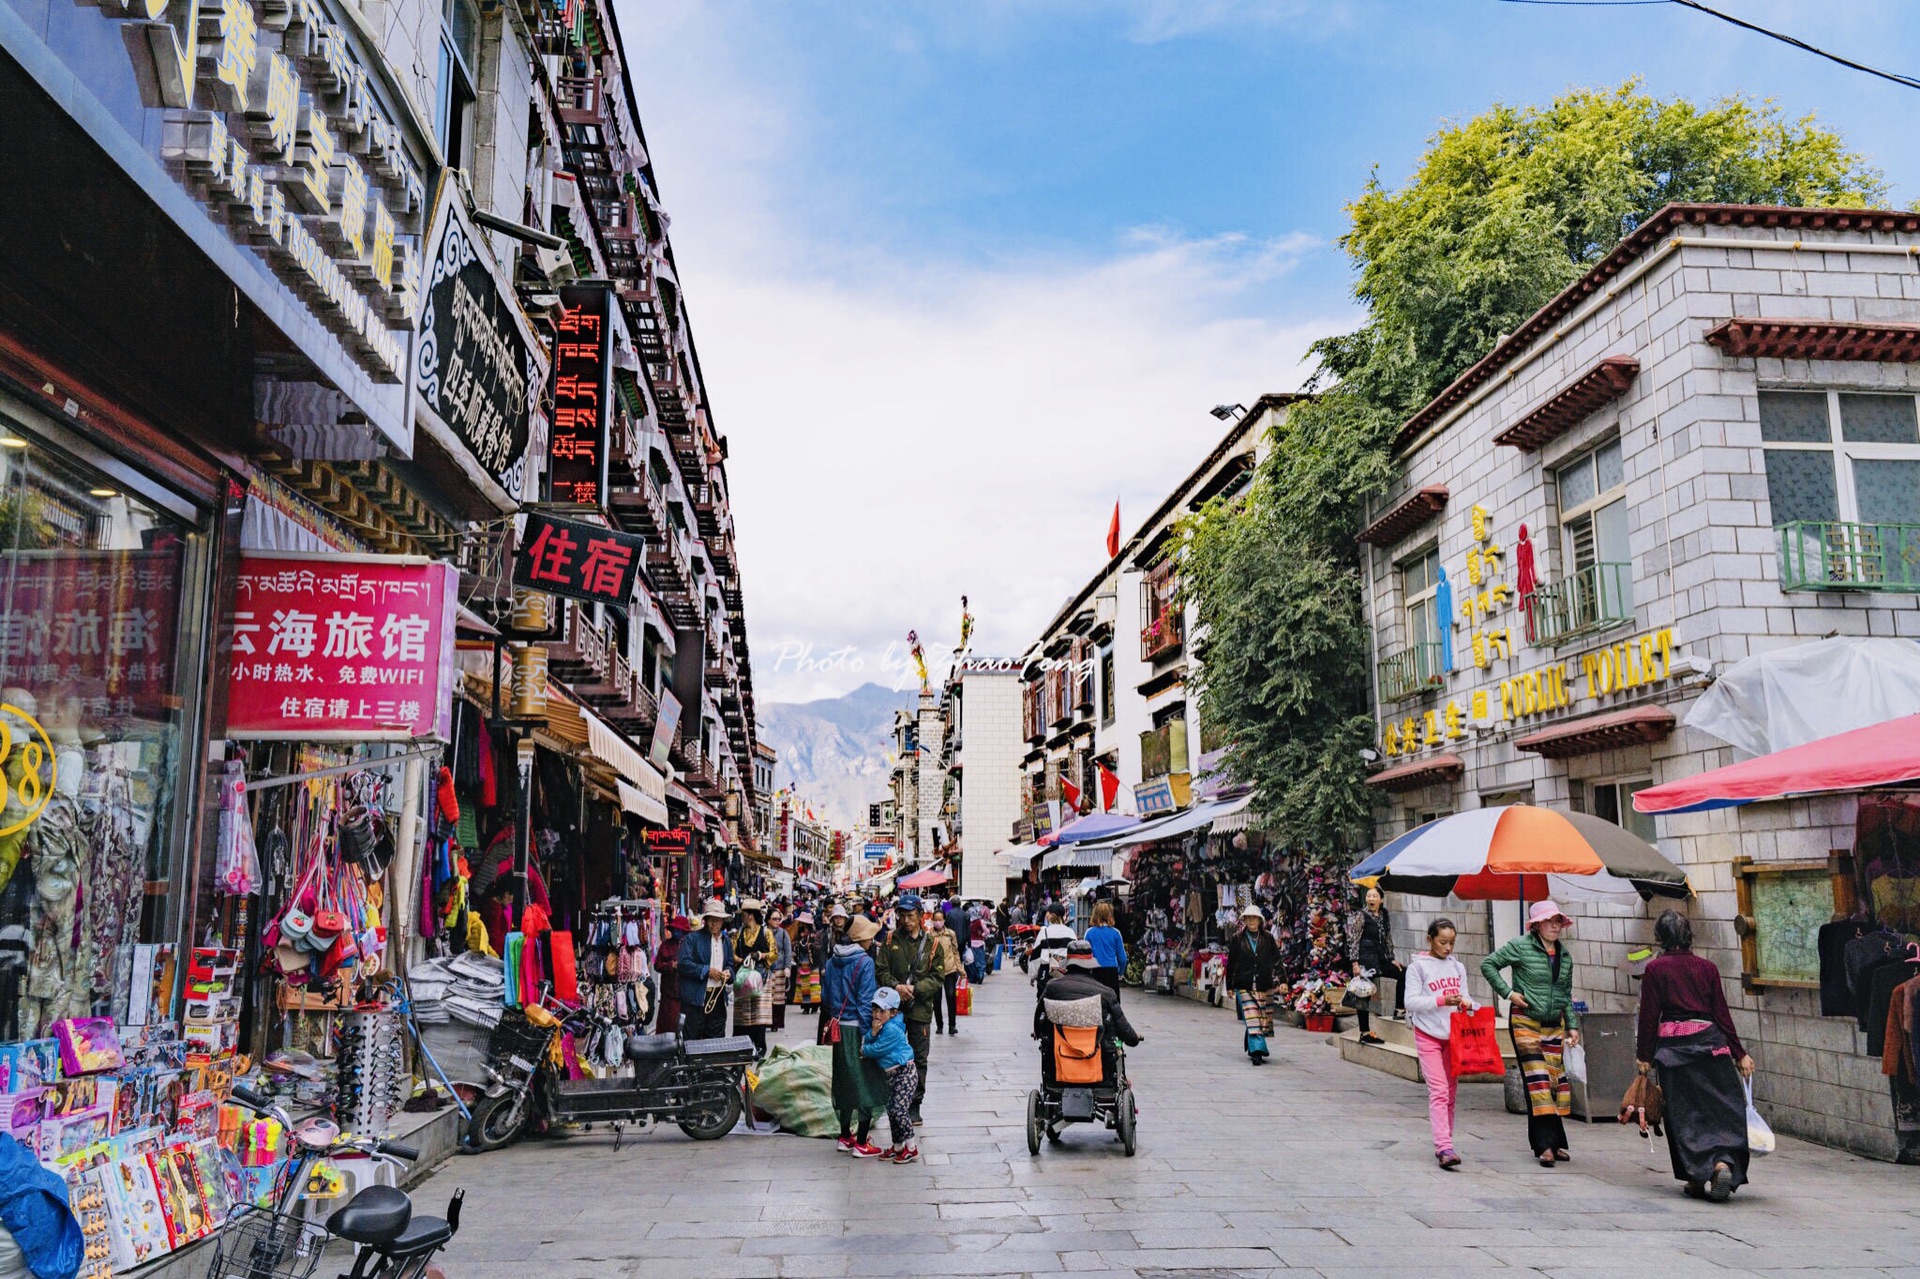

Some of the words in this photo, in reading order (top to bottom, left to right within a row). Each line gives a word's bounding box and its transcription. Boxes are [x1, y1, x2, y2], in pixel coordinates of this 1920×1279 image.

[528, 522, 633, 598] 住宿
[218, 608, 431, 662] 云海旅馆
[1500, 663, 1570, 721] PUBLIC
[1582, 627, 1673, 699] TOILET
[280, 696, 421, 722] 住宿请上三楼
